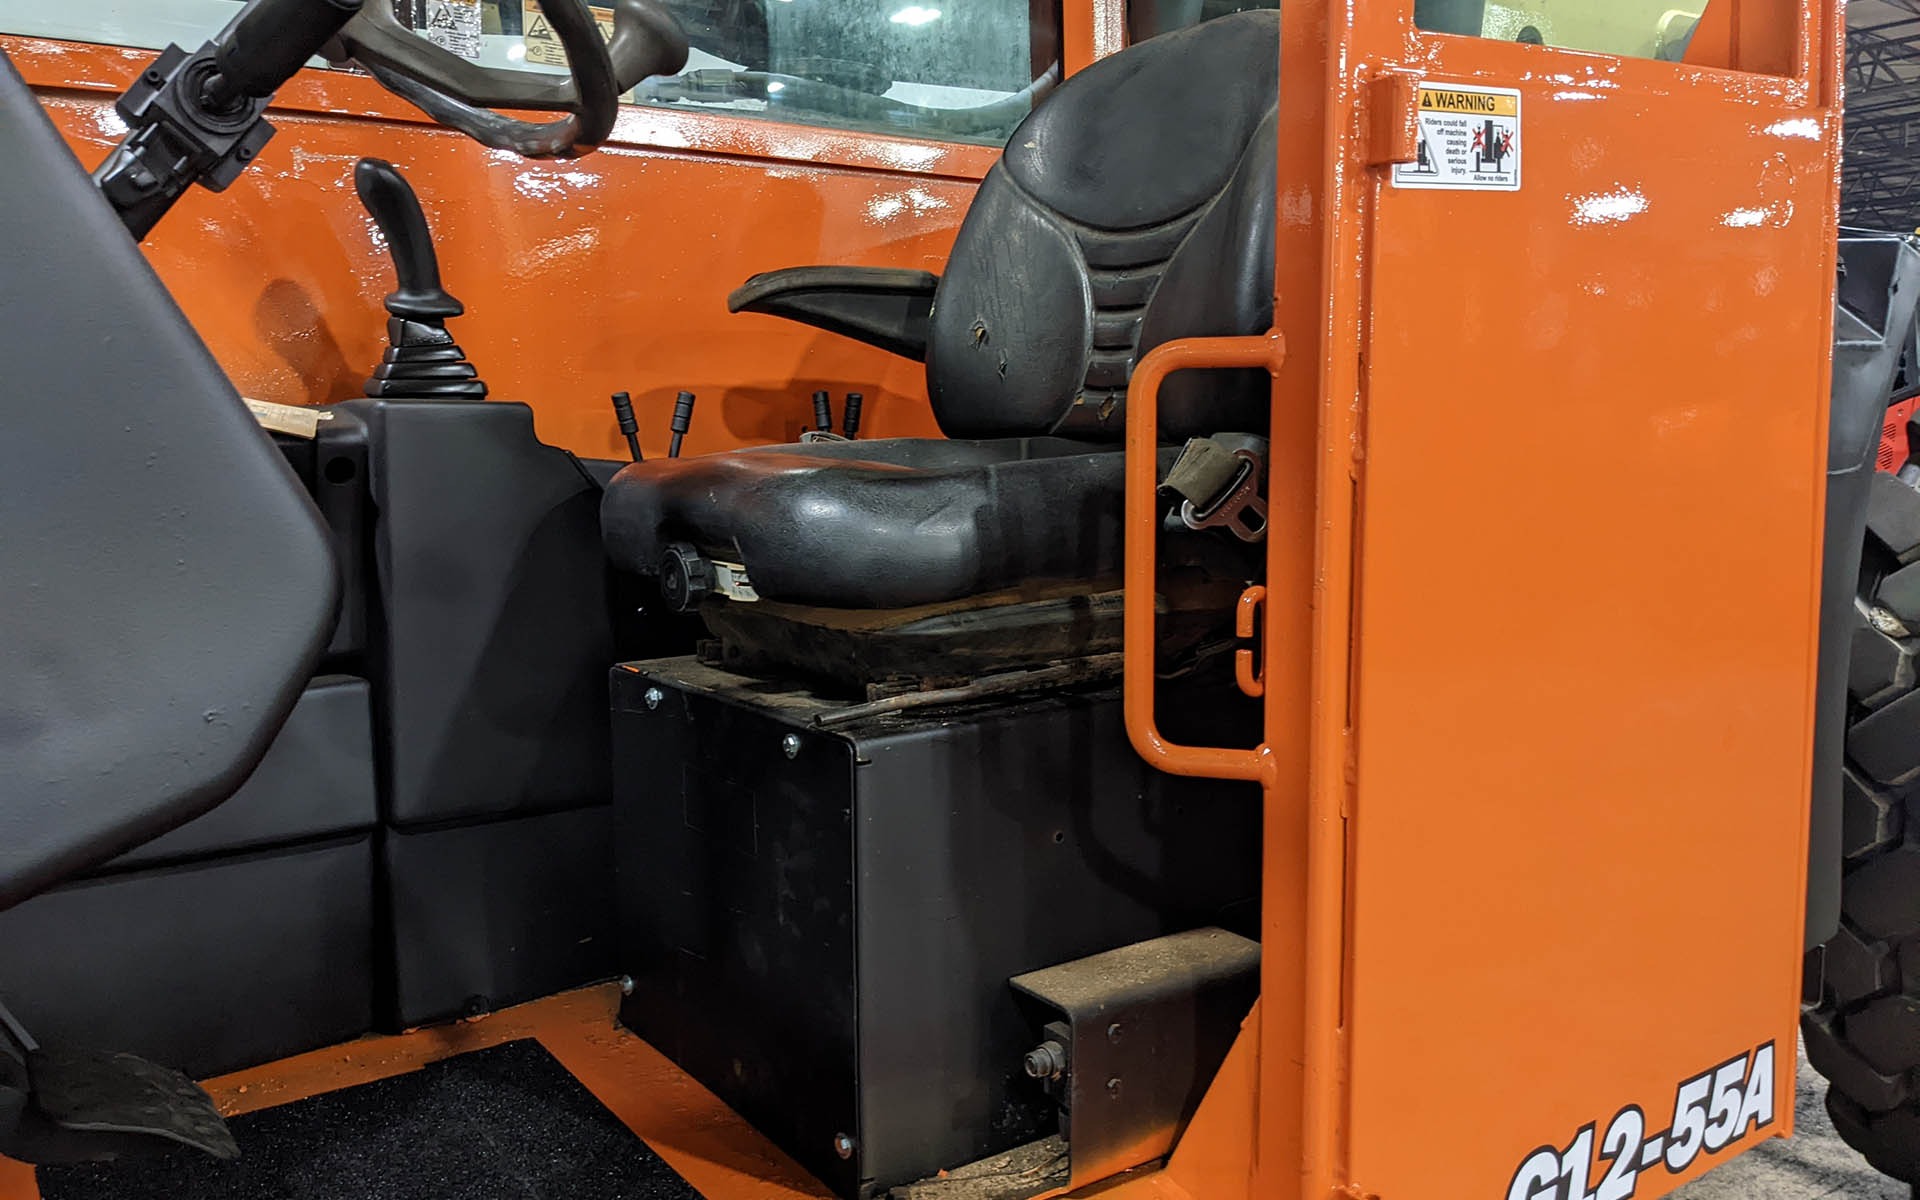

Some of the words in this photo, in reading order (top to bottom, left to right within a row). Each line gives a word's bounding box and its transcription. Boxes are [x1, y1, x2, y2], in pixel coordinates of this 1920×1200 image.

[1435, 92, 1495, 111] WARNING
[1447, 139, 1466, 147] causing
[1505, 1038, 1775, 1200] G12-55A
